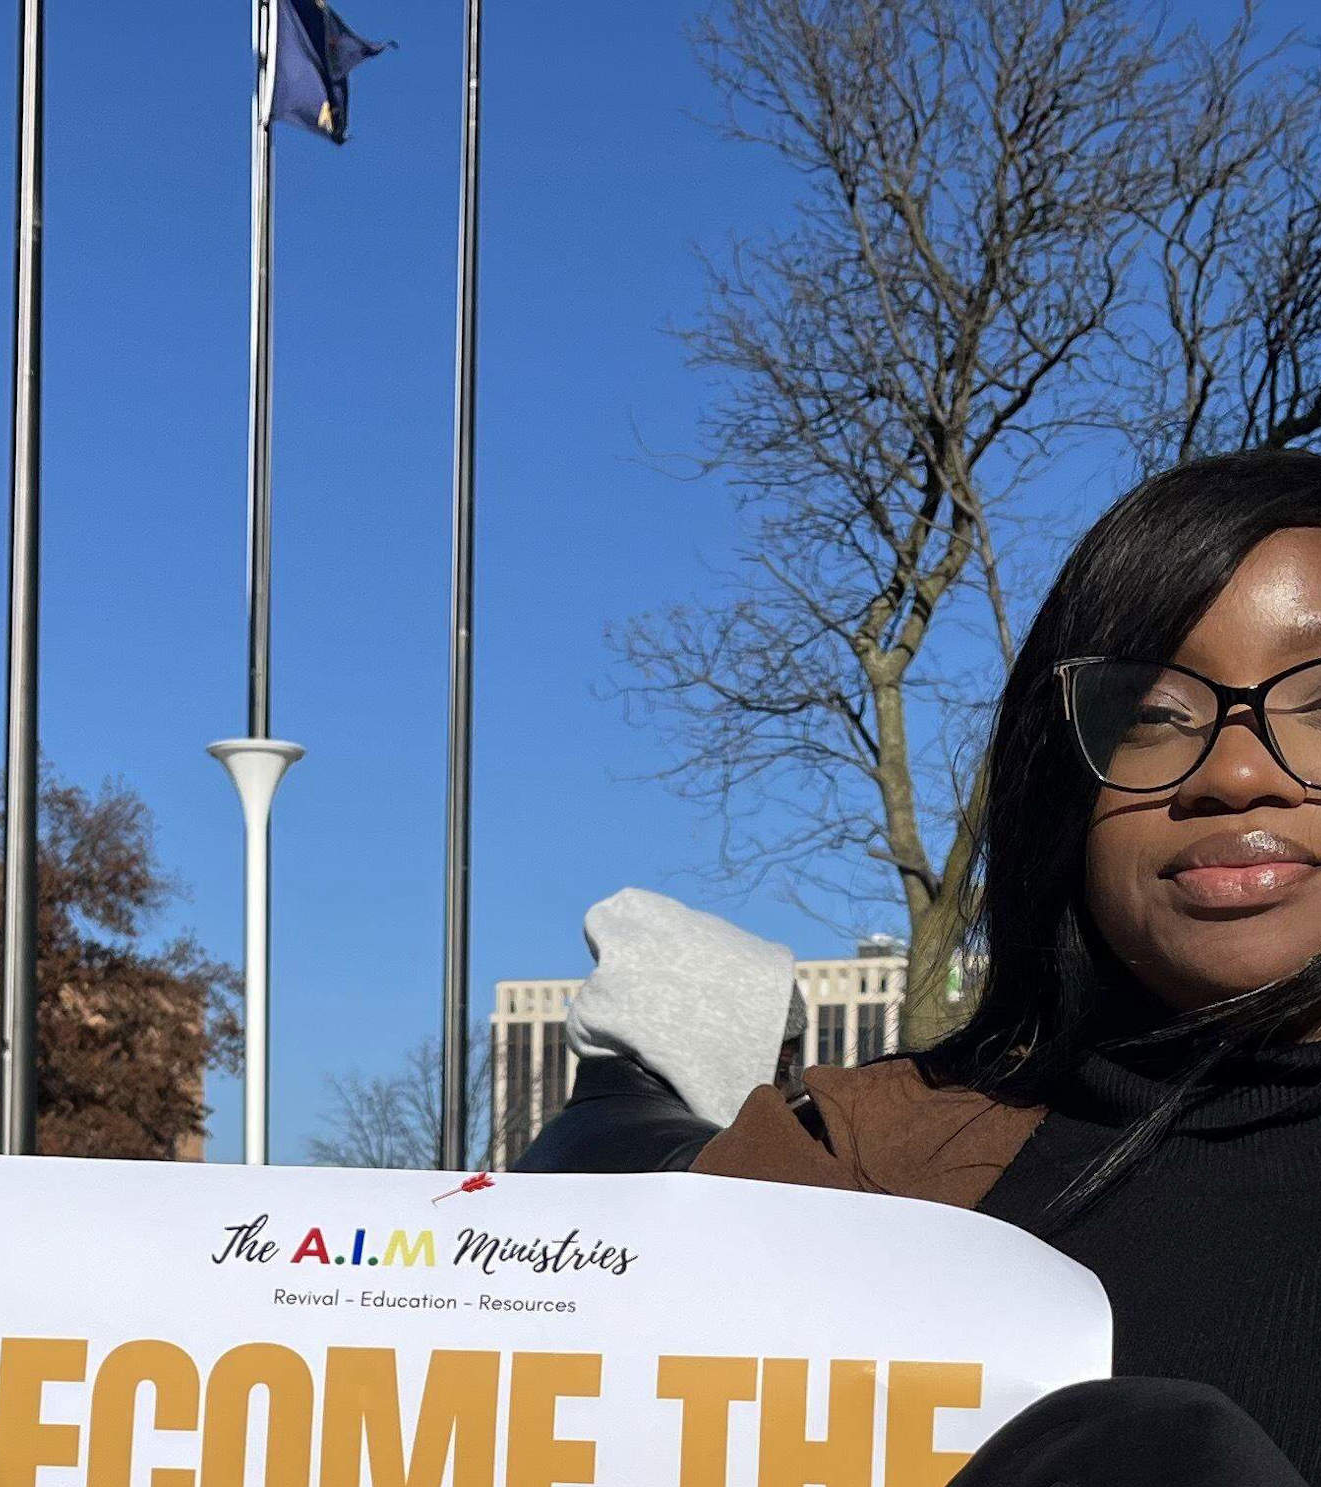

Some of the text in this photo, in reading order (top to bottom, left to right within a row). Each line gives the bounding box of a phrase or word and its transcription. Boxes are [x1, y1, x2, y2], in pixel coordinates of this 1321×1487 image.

[211, 1214, 639, 1276] The A.I.M Ministries
[274, 1288, 339, 1307] Revival
[360, 1290, 457, 1310] Education
[479, 1294, 576, 1313] Resources
